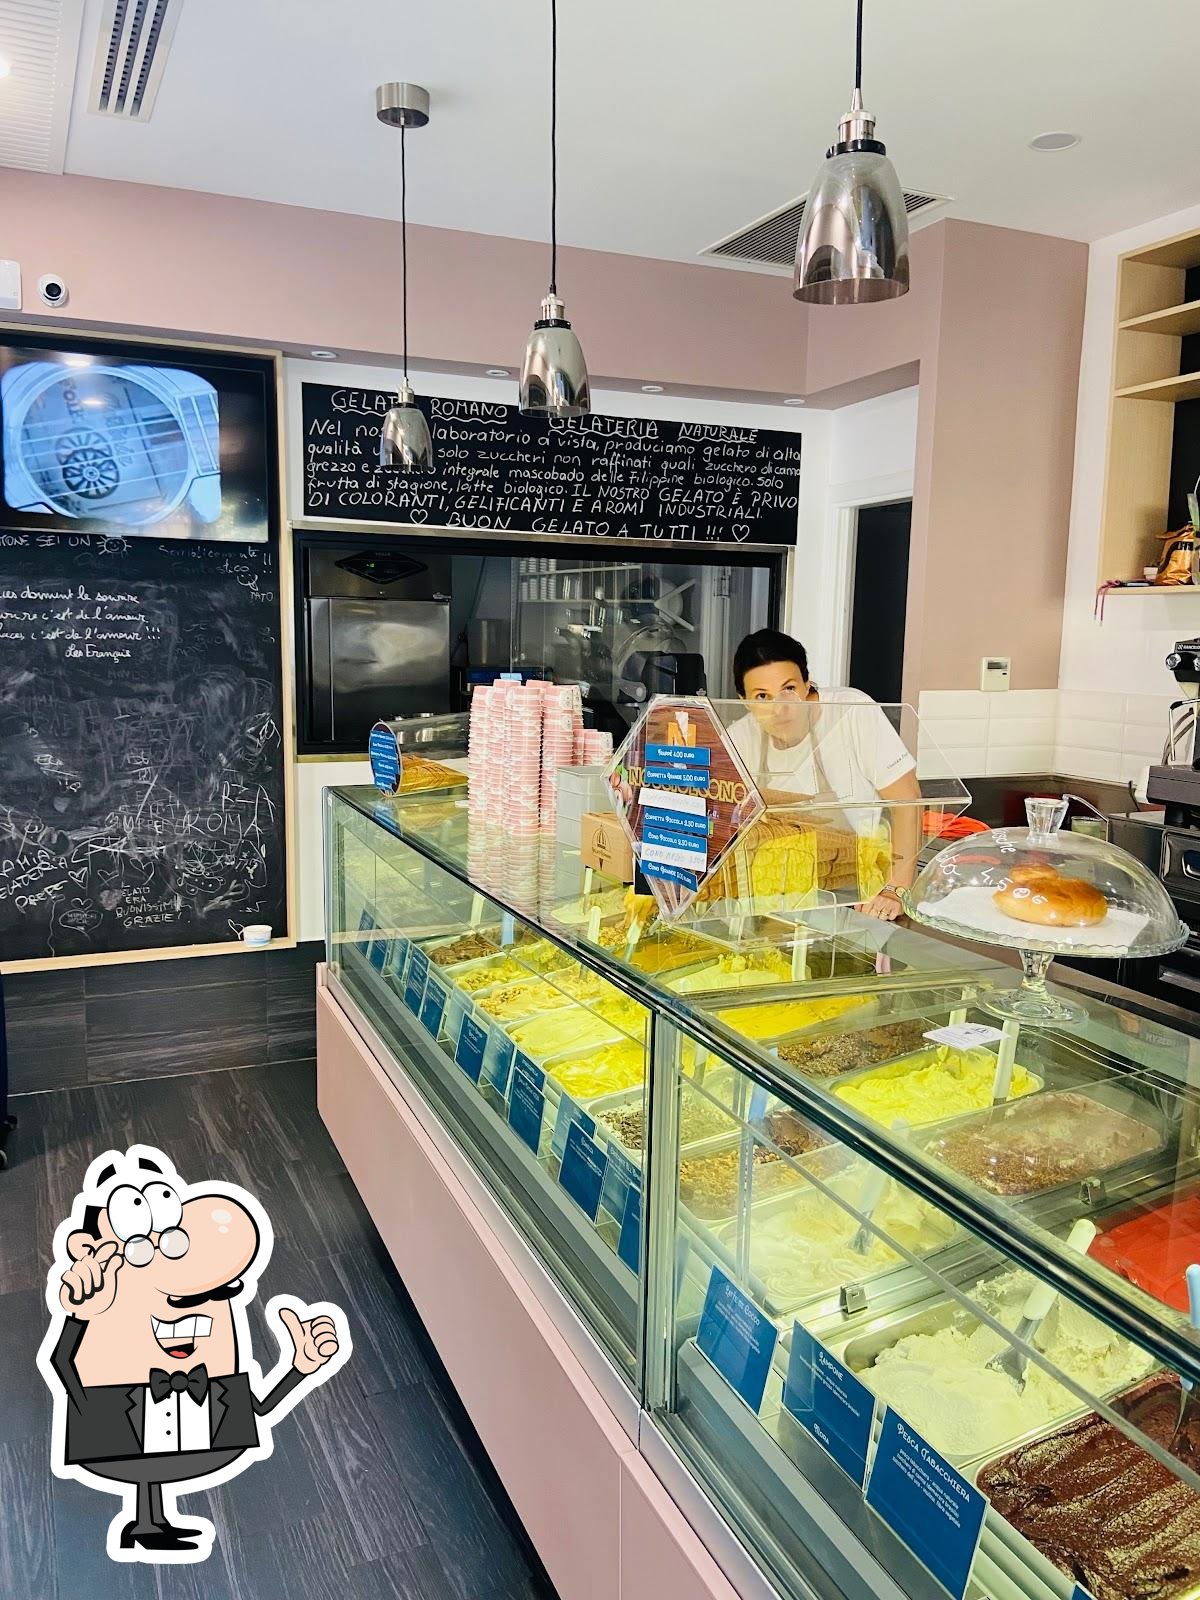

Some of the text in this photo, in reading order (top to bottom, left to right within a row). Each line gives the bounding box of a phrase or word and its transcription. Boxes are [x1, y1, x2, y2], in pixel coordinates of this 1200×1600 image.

[331, 389, 759, 441] GELAT ROMANO GELATERIA NATURALE
[309, 419, 341, 437] Nel
[431, 422, 531, 444] laboratorio
[537, 436, 550, 446] a
[558, 434, 600, 451] vista,
[603, 438, 695, 455] produciamo
[702, 444, 750, 462] gelato
[755, 446, 770, 459] di
[773, 447, 801, 461] alta
[308, 439, 362, 462] qualità
[437, 444, 469, 458] solo
[477, 450, 546, 464] zuccheri
[553, 454, 581, 466] non
[592, 451, 652, 473] raffinati
[660, 456, 695, 477] quali
[705, 461, 757, 475] zucchero
[306, 461, 356, 479] grezzo
[361, 463, 370, 474] e
[443, 462, 500, 482] integrale
[508, 465, 585, 481] mascobado
[590, 469, 624, 484] delle
[628, 471, 685, 490] Filippine
[307, 477, 359, 494] frutta
[366, 474, 380, 489] di
[456, 479, 494, 493] latte
[571, 483, 592, 497] IL
[598, 485, 650, 500] NOSTRO
[659, 485, 724, 503] GELATO
[751, 490, 798, 509] PRIVO
[308, 491, 330, 507] DI
[338, 491, 451, 512] COLORANTI,
[454, 495, 565, 513] GELIFICANTI
[572, 498, 585, 513] E
[590, 499, 644, 516] AROMI
[68, 534, 92, 548] UN
[445, 511, 512, 530] BUON
[531, 516, 610, 536] GELATO
[617, 523, 629, 538] A
[640, 523, 696, 540] TUTTI
[77, 584, 92, 600] le
[897, 1422, 970, 1503] PESCA TABACCHIERA
